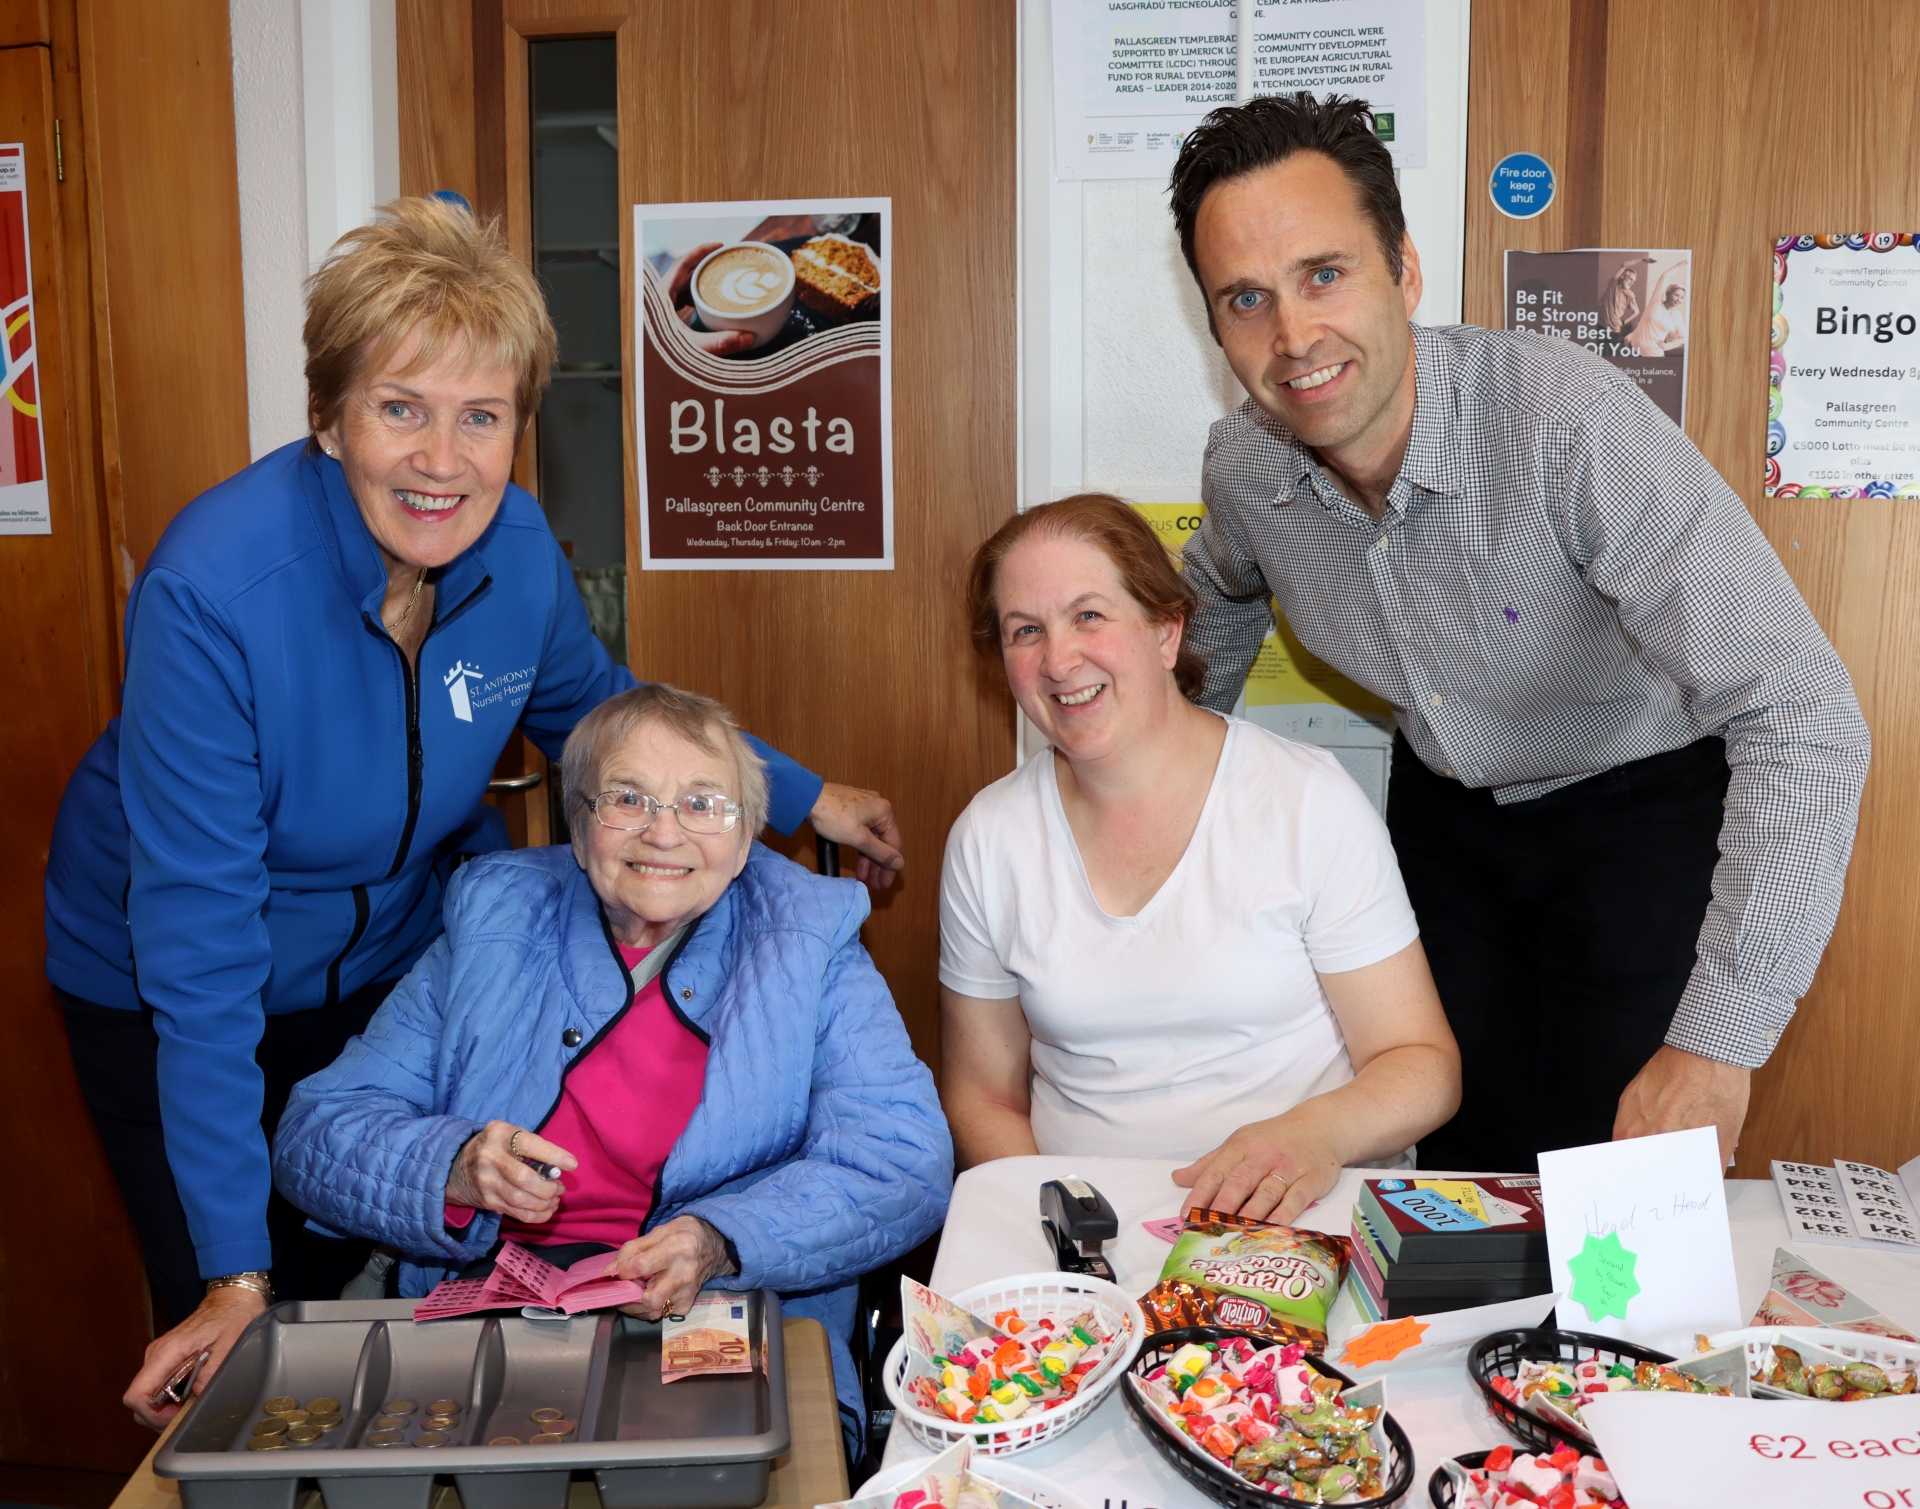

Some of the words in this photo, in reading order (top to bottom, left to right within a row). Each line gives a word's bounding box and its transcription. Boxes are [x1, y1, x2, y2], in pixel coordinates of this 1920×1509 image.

[1115, 37, 1176, 46] PALLASGREEN
[1179, 35, 1237, 44] TEMPLEBRAD
[1254, 32, 1311, 41] COMMUNITY
[1313, 29, 1356, 38] COUNCIL
[1358, 27, 1384, 35] WERE
[1113, 49, 1165, 57] SUPPORTED
[1181, 47, 1223, 55] LIMERICK
[1258, 43, 1316, 53] COMMUNITY
[1319, 39, 1386, 50] DEVELOPMENT
[1108, 61, 1163, 69] COMMITTEE
[1166, 60, 1196, 68] (LCDC)
[1270, 55, 1319, 64] EUROPEAN
[1322, 51, 1391, 61] AGRICULTURAL
[1108, 73, 1132, 81] FUND
[1155, 72, 1184, 80] RURAL
[1259, 68, 1295, 76] EUROPE
[1298, 65, 1347, 75] INVESTING
[1362, 62, 1392, 71] RURAL
[1155, 84, 1188, 92] LEADER
[1191, 82, 1236, 91] 2014-2020
[1261, 78, 1325, 88] TECHNOLOGY
[1328, 75, 1370, 85] UPGRADE
[1186, 94, 1236, 103] PALLASGRE
[1500, 168, 1519, 178] Fire
[1522, 168, 1546, 178] door
[1510, 181, 1535, 192] keep
[1511, 193, 1533, 203] shut
[1879, 236, 1890, 245] 19
[1829, 279, 1875, 288] Community
[1877, 279, 1907, 287] Council
[1516, 290, 1537, 305] Be
[1543, 290, 1563, 305] Fit
[1516, 307, 1537, 322] Be
[1543, 307, 1598, 326] Strong
[1542, 325, 1571, 339] The
[1577, 325, 1612, 339] Best
[1816, 306, 1916, 343] Bingo
[1584, 342, 1604, 357] Of
[1609, 343, 1640, 357] You
[1642, 367, 1676, 376] balance,
[1790, 366, 1826, 380] Every
[1830, 366, 1906, 380] Wednesday
[1826, 402, 1896, 414] Pallasgreen
[670, 398, 854, 456] Blasta
[1815, 419, 1872, 429] Community
[1875, 419, 1909, 427] Centre
[1793, 441, 1829, 450] €5000
[1832, 441, 1860, 450] Lotto
[1863, 442, 1890, 450] must
[1893, 442, 1905, 451] be
[1850, 457, 1871, 467] plus
[1808, 471, 1840, 479] €1500
[1855, 471, 1881, 480] other
[1885, 472, 1914, 480] prizes
[665, 498, 741, 516] Pallasgreen
[745, 497, 818, 516] Community
[821, 496, 865, 512] Centre
[717, 521, 742, 531] Back
[744, 521, 768, 531] Door
[770, 520, 813, 531] Entrance
[1176, 516, 1202, 530] CO
[687, 538, 729, 548] Wednesday,
[731, 538, 764, 548] Thursday
[766, 538, 773, 546] &
[775, 538, 800, 548] Friday:
[801, 538, 821, 546] 10am
[828, 538, 845, 547] 2pm
[470, 686, 482, 698] ST.
[484, 666, 537, 692] ANTHONY'S
[472, 691, 503, 710] Nursing
[504, 682, 531, 696] Home
[1782, 1164, 1826, 1176] 335
[1845, 1164, 1890, 1180] 325
[1785, 1178, 1831, 1190] 334
[1850, 1177, 1896, 1194] 324
[1790, 1192, 1836, 1204] 333
[1856, 1192, 1902, 1209] 323
[1401, 1198, 1460, 1227] 1000
[1585, 1200, 1636, 1239] Head
[1794, 1206, 1842, 1219] 332
[1861, 1208, 1909, 1224] 322
[1802, 1222, 1848, 1234] 331
[1870, 1224, 1916, 1240] 321
[1204, 1265, 1314, 1300] Orange
[1220, 1301, 1262, 1326] Oatfield
[719, 1337, 745, 1354] 10
[1748, 1434, 1817, 1459] €2
[1827, 1432, 1920, 1459] eac
[1863, 1488, 1912, 1509] or
